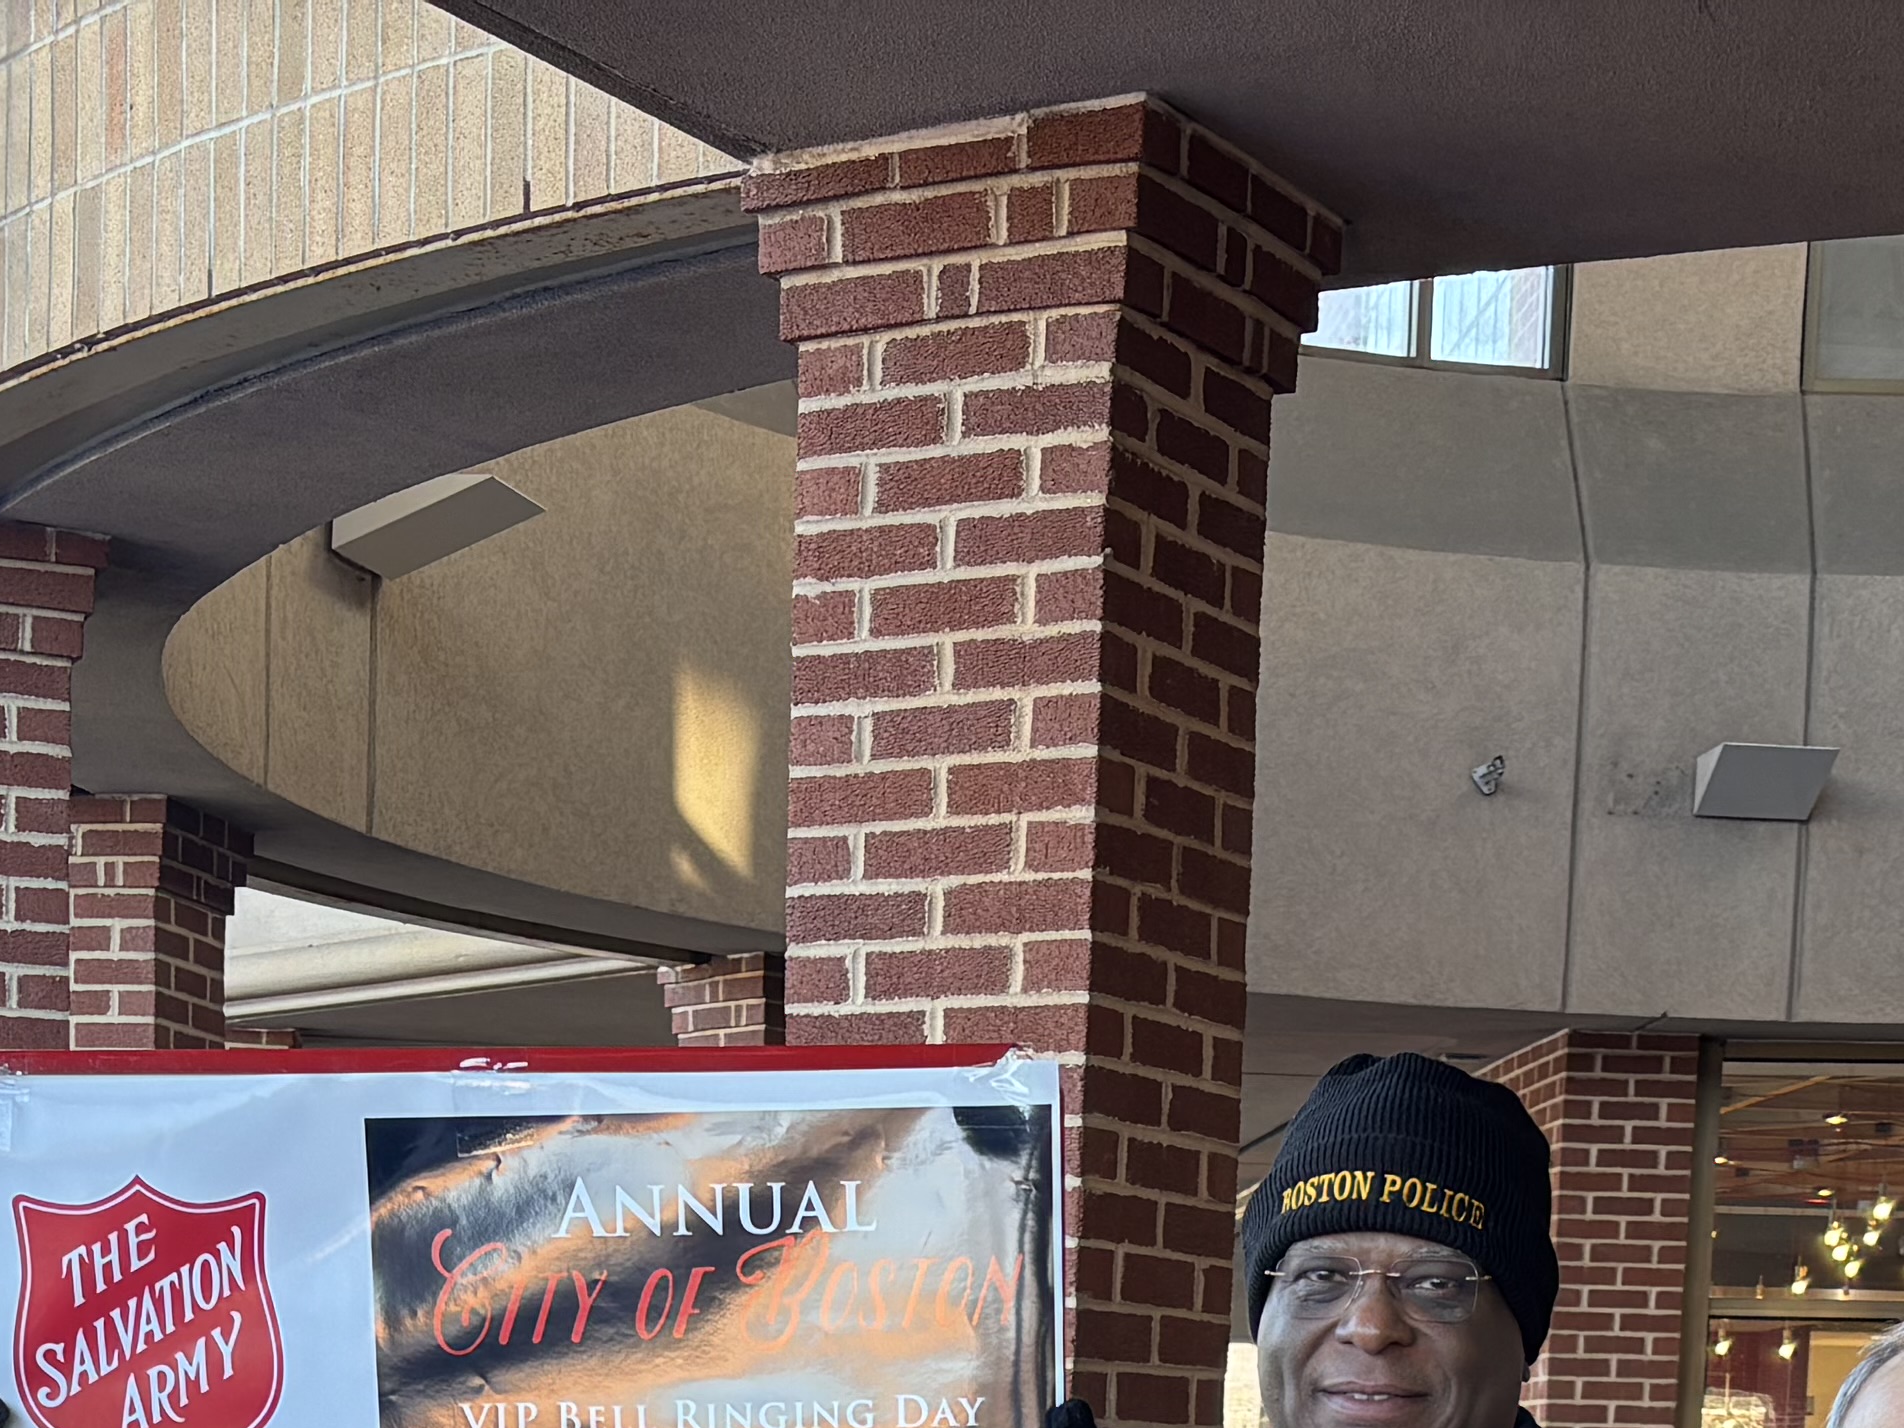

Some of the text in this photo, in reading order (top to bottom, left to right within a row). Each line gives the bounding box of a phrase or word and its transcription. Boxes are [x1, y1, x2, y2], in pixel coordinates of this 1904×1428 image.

[551, 1176, 877, 1239] ANNUAL
[1281, 1170, 1485, 1229] BOSTON POLICE
[61, 1213, 157, 1309] THE
[635, 1266, 716, 1341] OF
[736, 1227, 1026, 1352] BOSTON
[35, 1225, 246, 1410] SALVATION
